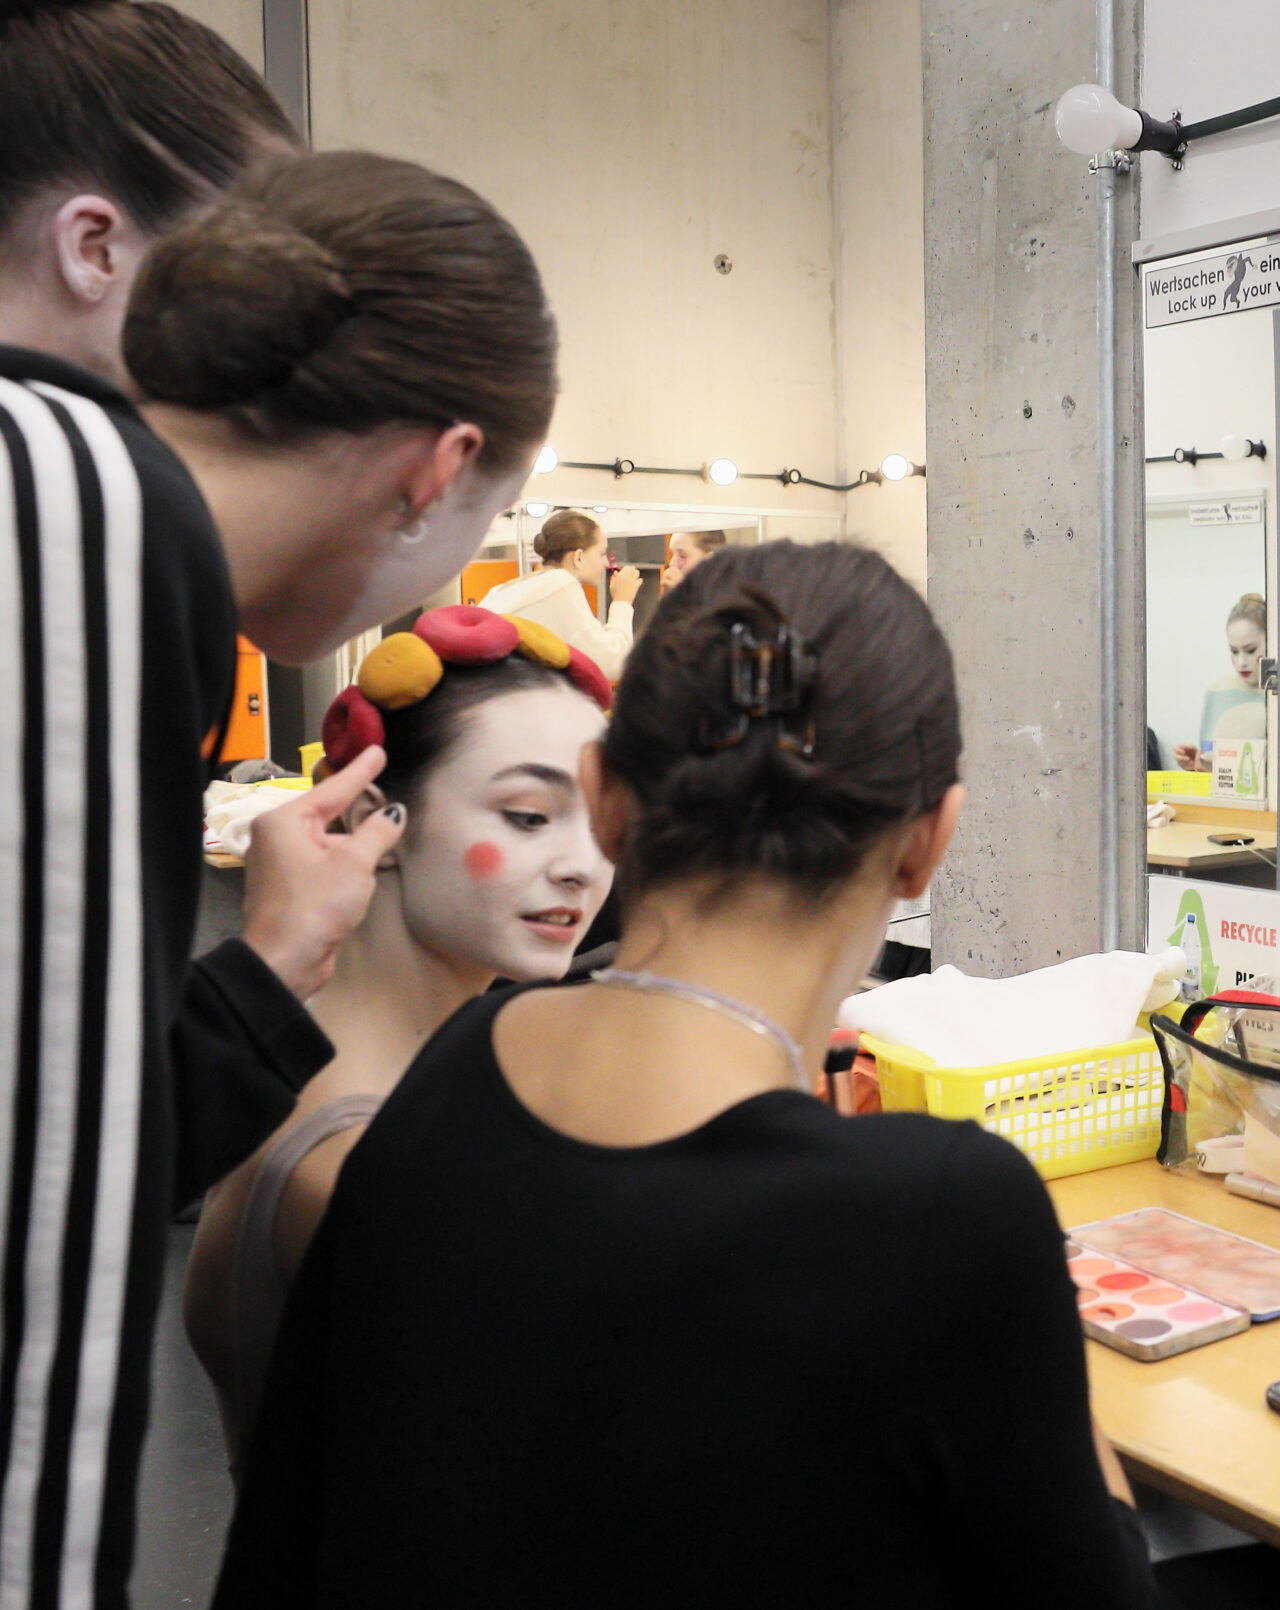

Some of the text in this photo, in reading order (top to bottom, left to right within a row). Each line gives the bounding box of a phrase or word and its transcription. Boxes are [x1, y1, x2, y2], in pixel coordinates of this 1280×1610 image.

[1149, 267, 1225, 297] Wertsachen
[1168, 296, 1197, 314] Lock
[1200, 293, 1217, 310] up
[1242, 281, 1272, 303] your
[1220, 919, 1277, 948] RECYCLE
